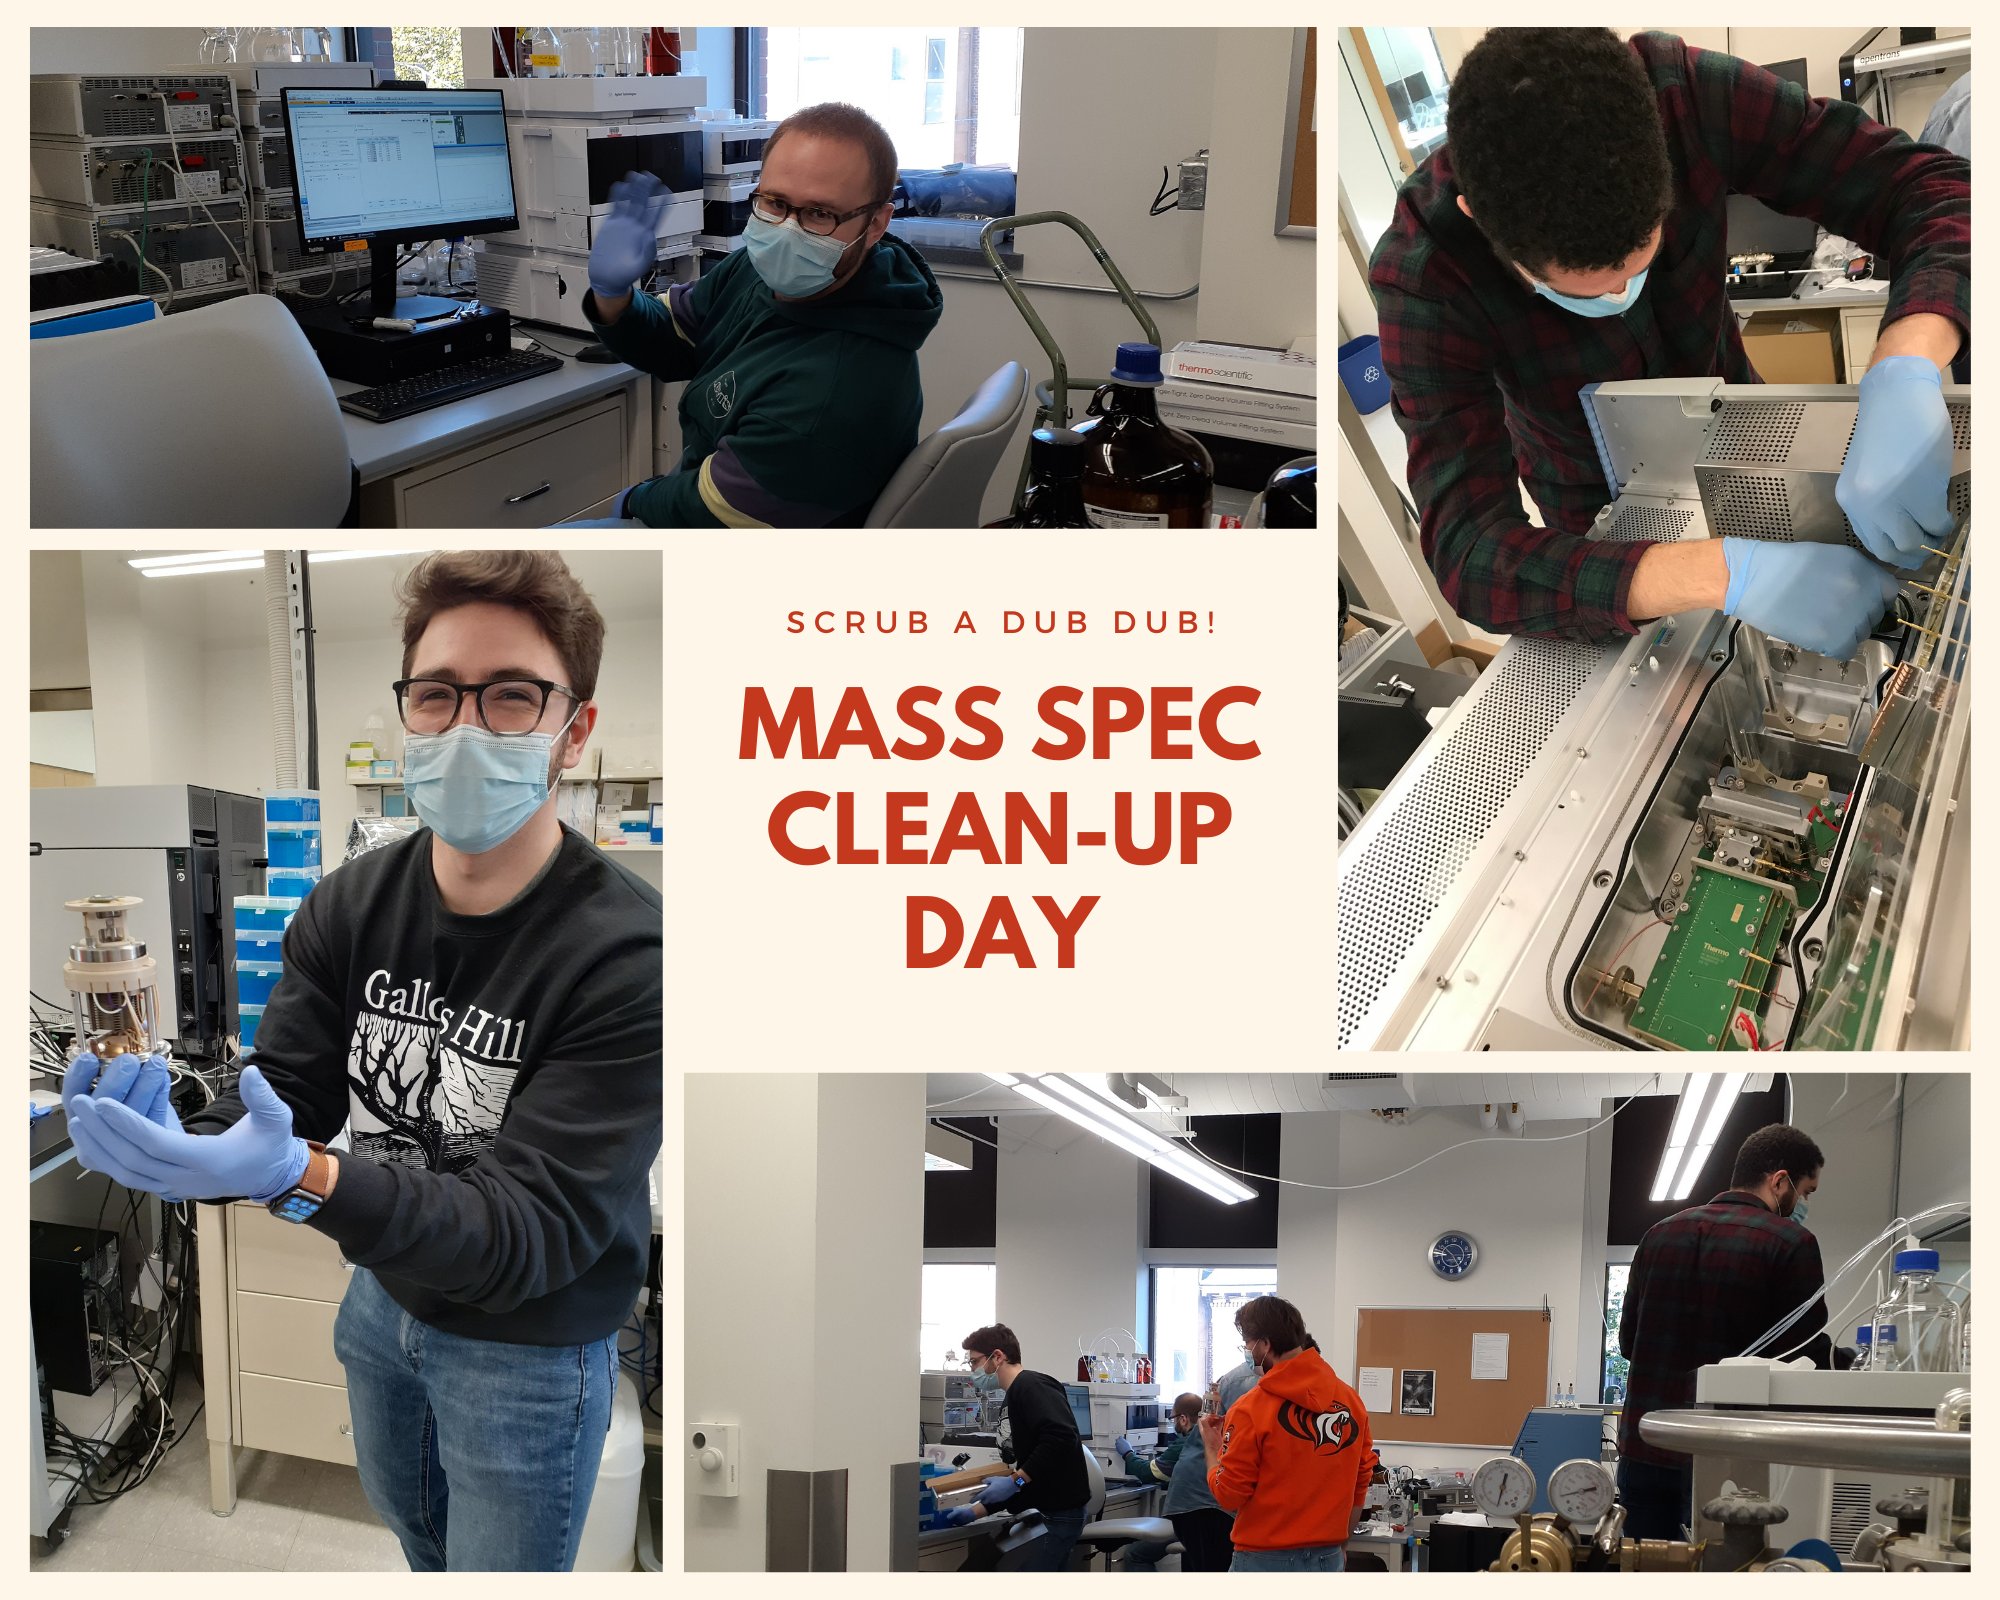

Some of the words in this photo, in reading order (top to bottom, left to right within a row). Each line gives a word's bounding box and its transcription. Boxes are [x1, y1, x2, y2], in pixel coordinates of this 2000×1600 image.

[1860, 50, 1900, 64] opentrons
[1205, 394, 1225, 403] Dead
[1226, 397, 1253, 406] Volume
[1275, 403, 1300, 412] System
[450, 1004, 526, 1063] Hill
